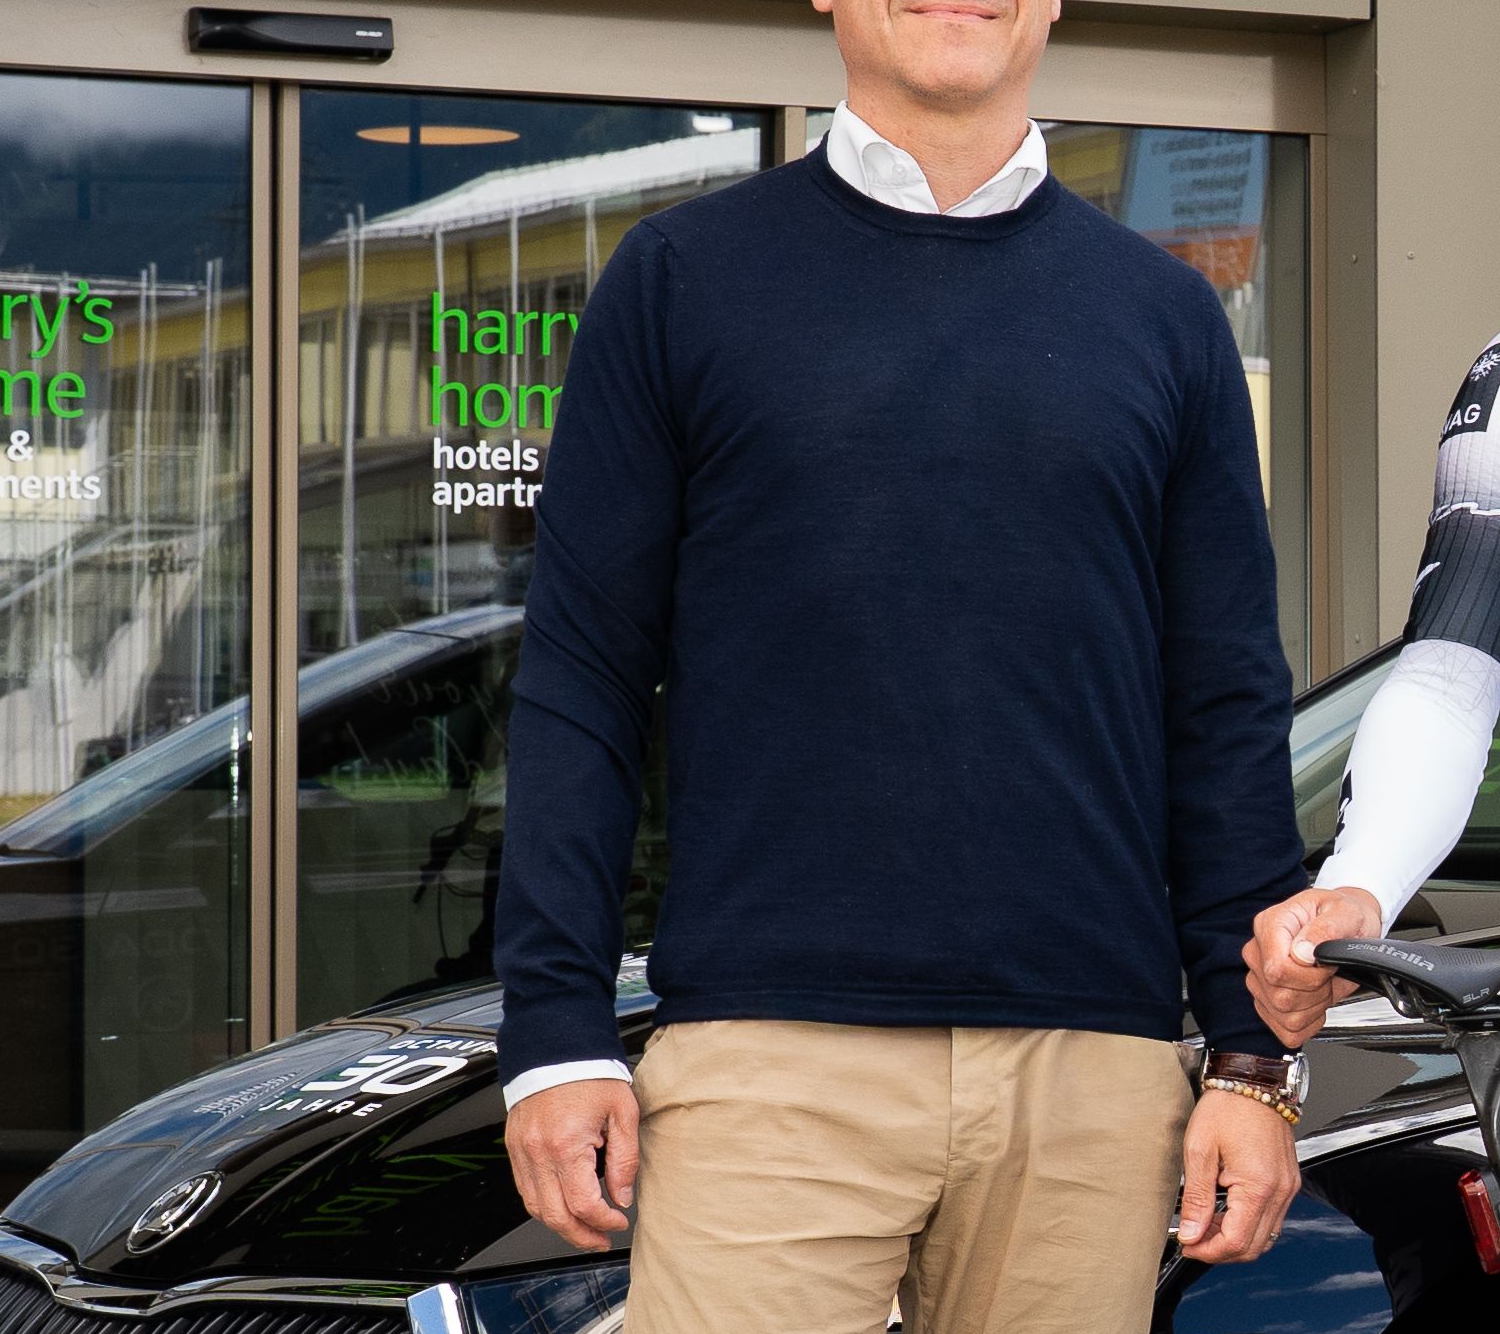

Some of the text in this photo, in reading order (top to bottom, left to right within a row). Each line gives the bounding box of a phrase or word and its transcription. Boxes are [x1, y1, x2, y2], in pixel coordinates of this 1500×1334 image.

[6, 430, 34, 462] &
[434, 437, 540, 471] hotels
[1462, 987, 1490, 1004] SLR
[300, 1054, 469, 1095] 30
[259, 1098, 383, 1117] JAHRE
